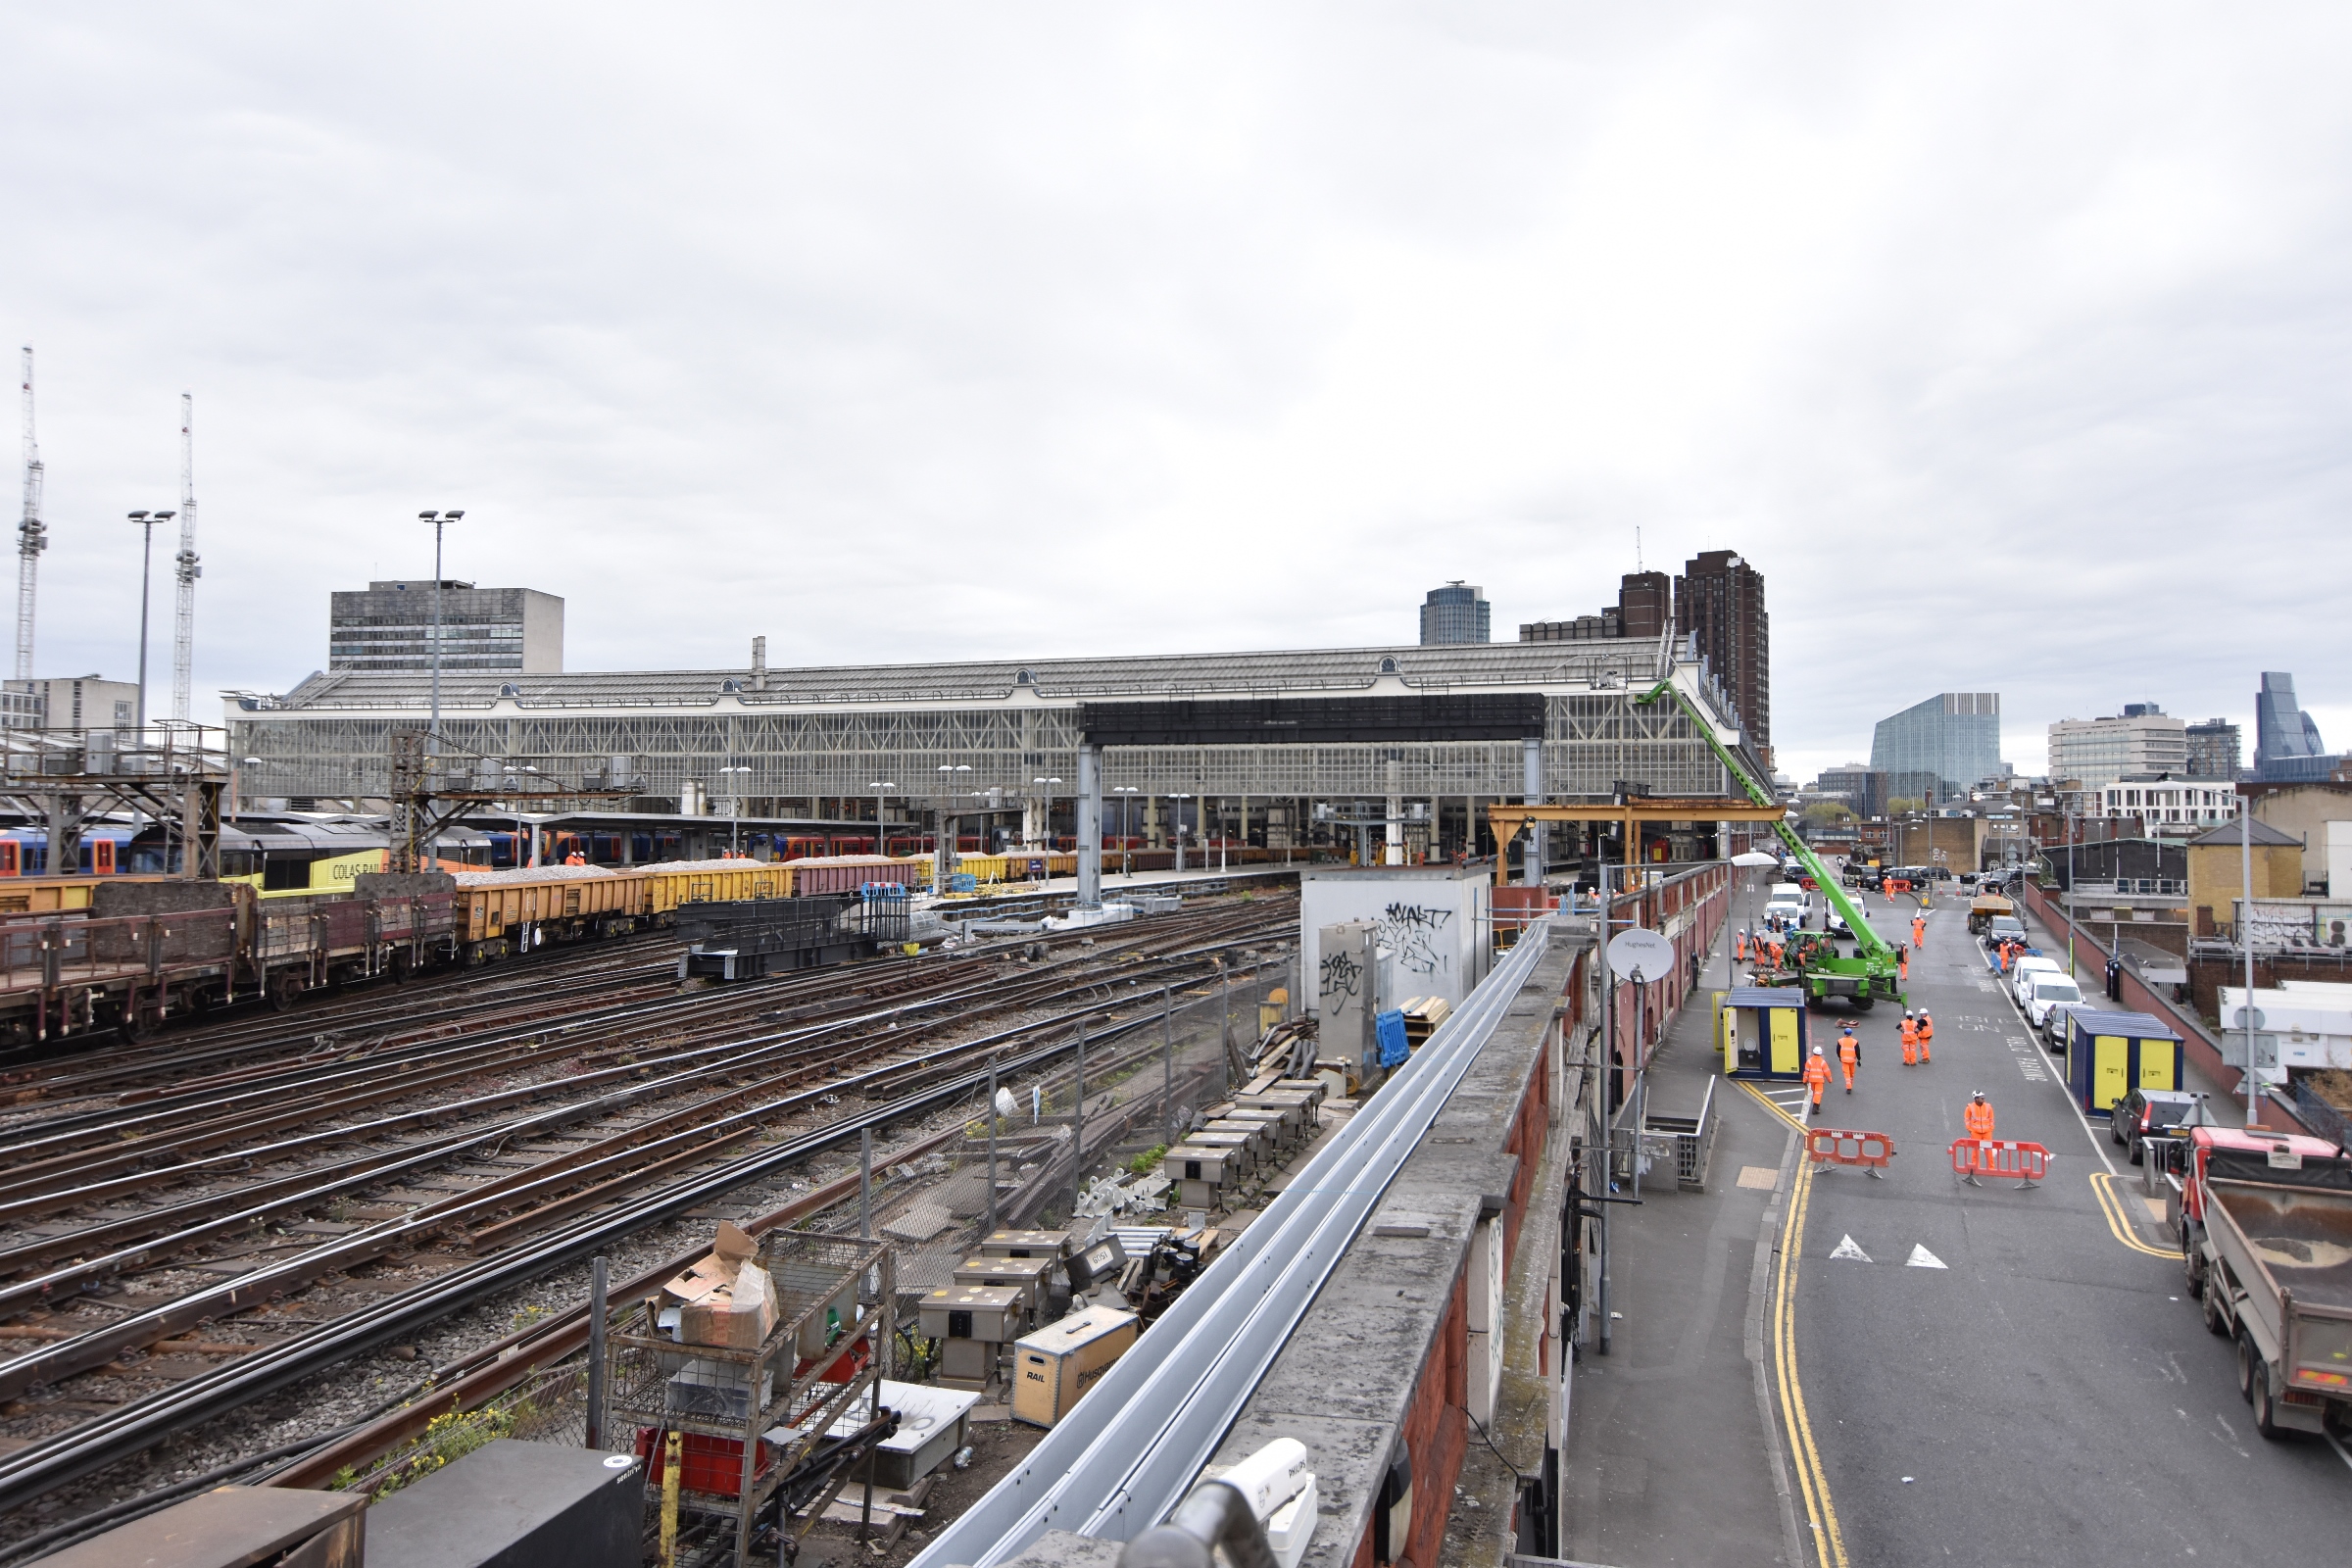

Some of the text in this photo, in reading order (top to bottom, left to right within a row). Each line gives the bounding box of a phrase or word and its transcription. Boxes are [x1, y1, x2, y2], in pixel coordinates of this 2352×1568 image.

[333, 864, 361, 879] COLAS
[1026, 1371, 1045, 1383] RAIL
[1288, 1459, 1305, 1478] PHILIPS
